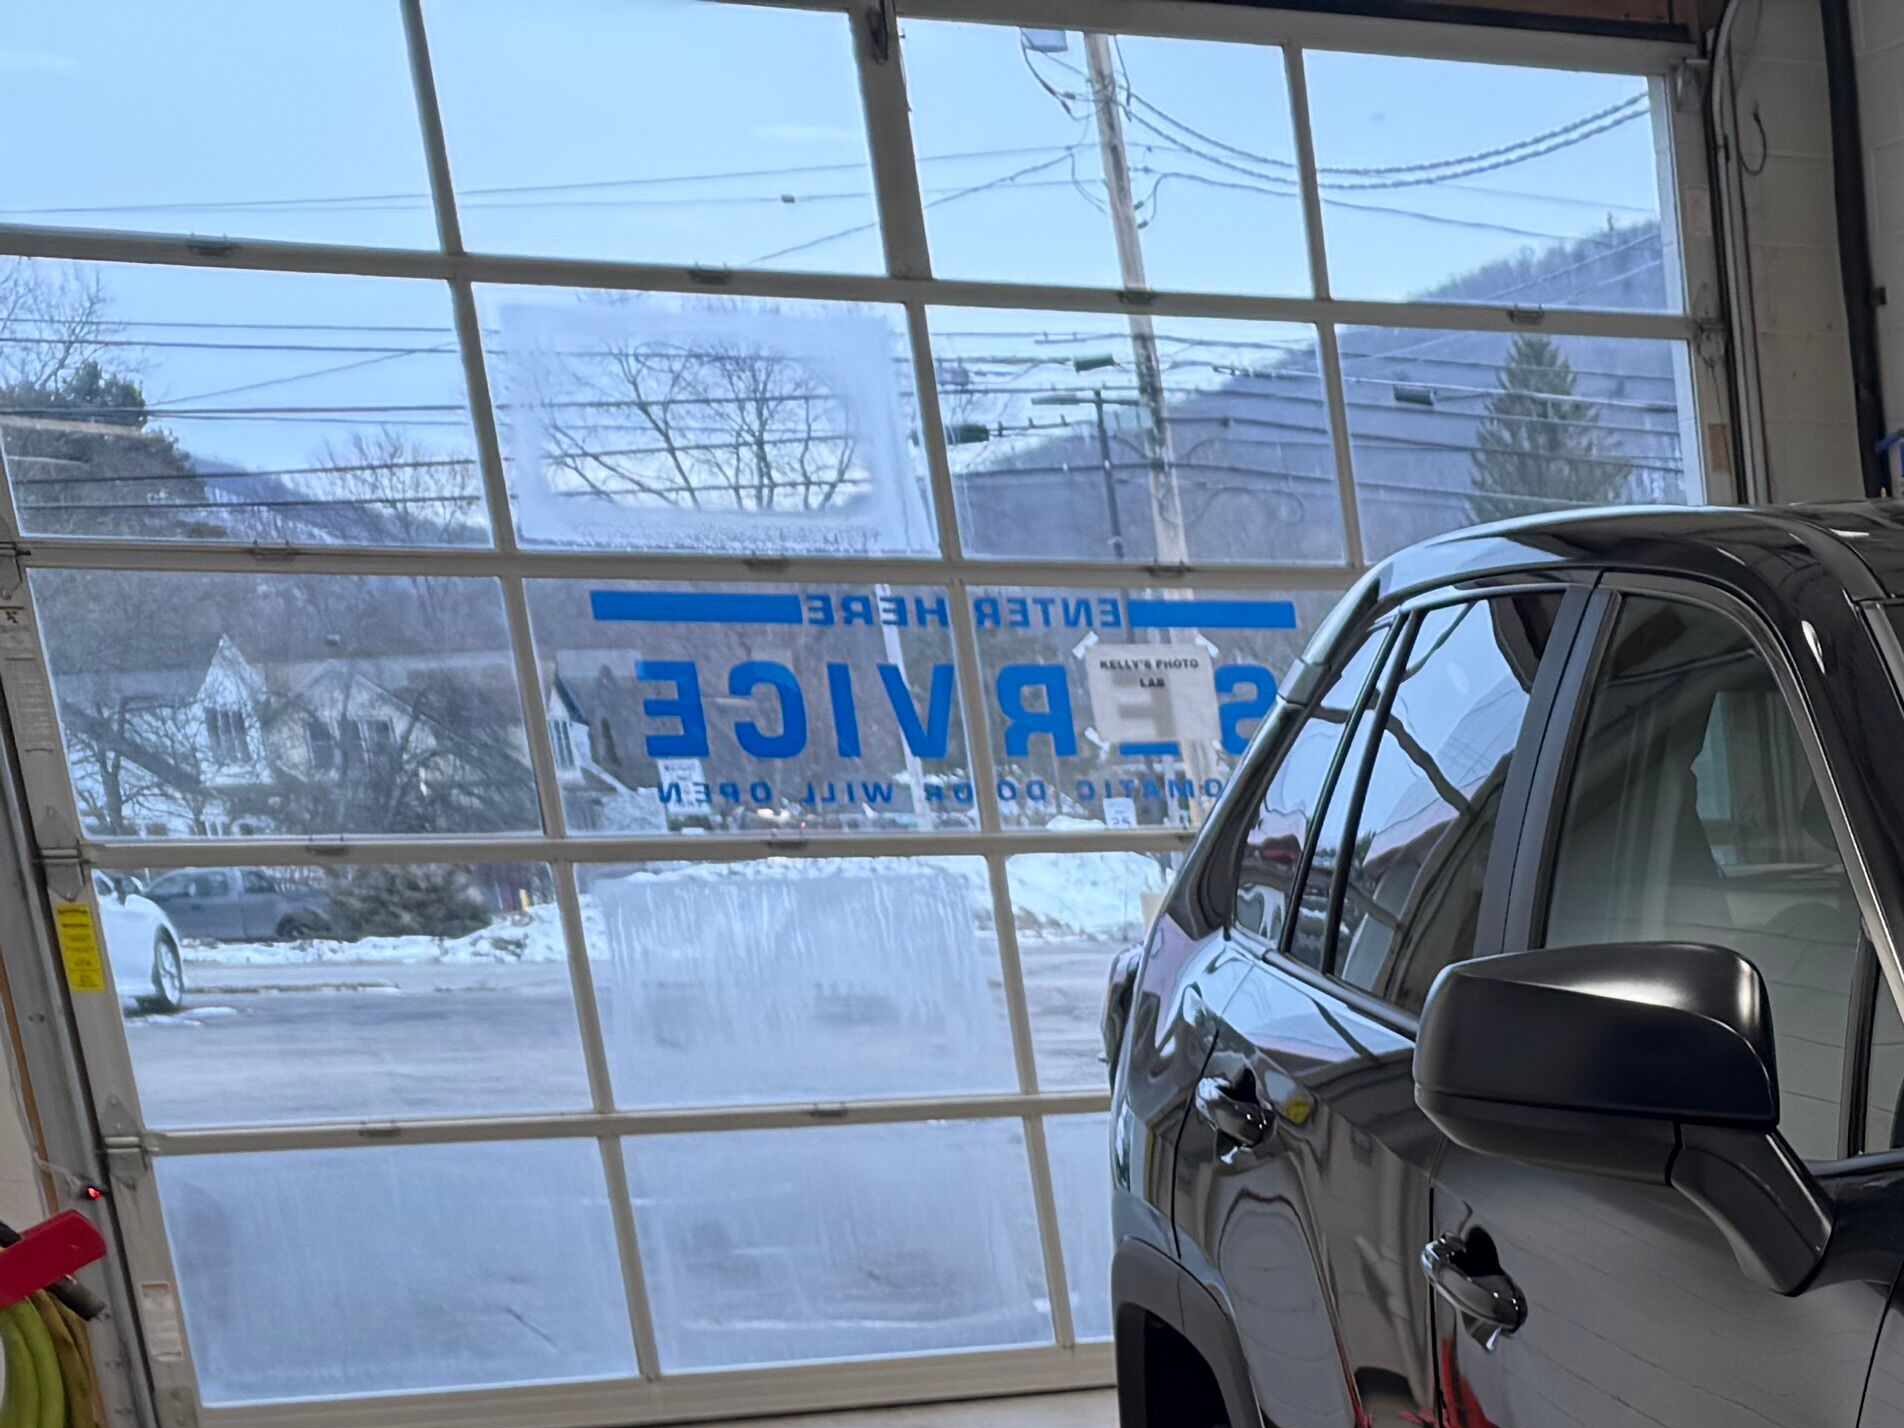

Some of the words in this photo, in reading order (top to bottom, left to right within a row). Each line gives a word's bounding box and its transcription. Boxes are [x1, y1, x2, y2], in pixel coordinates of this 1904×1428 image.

[1099, 658, 1151, 670] KELLY'S
[1155, 658, 1200, 669] PHOTO
[1139, 677, 1166, 689] LAB
